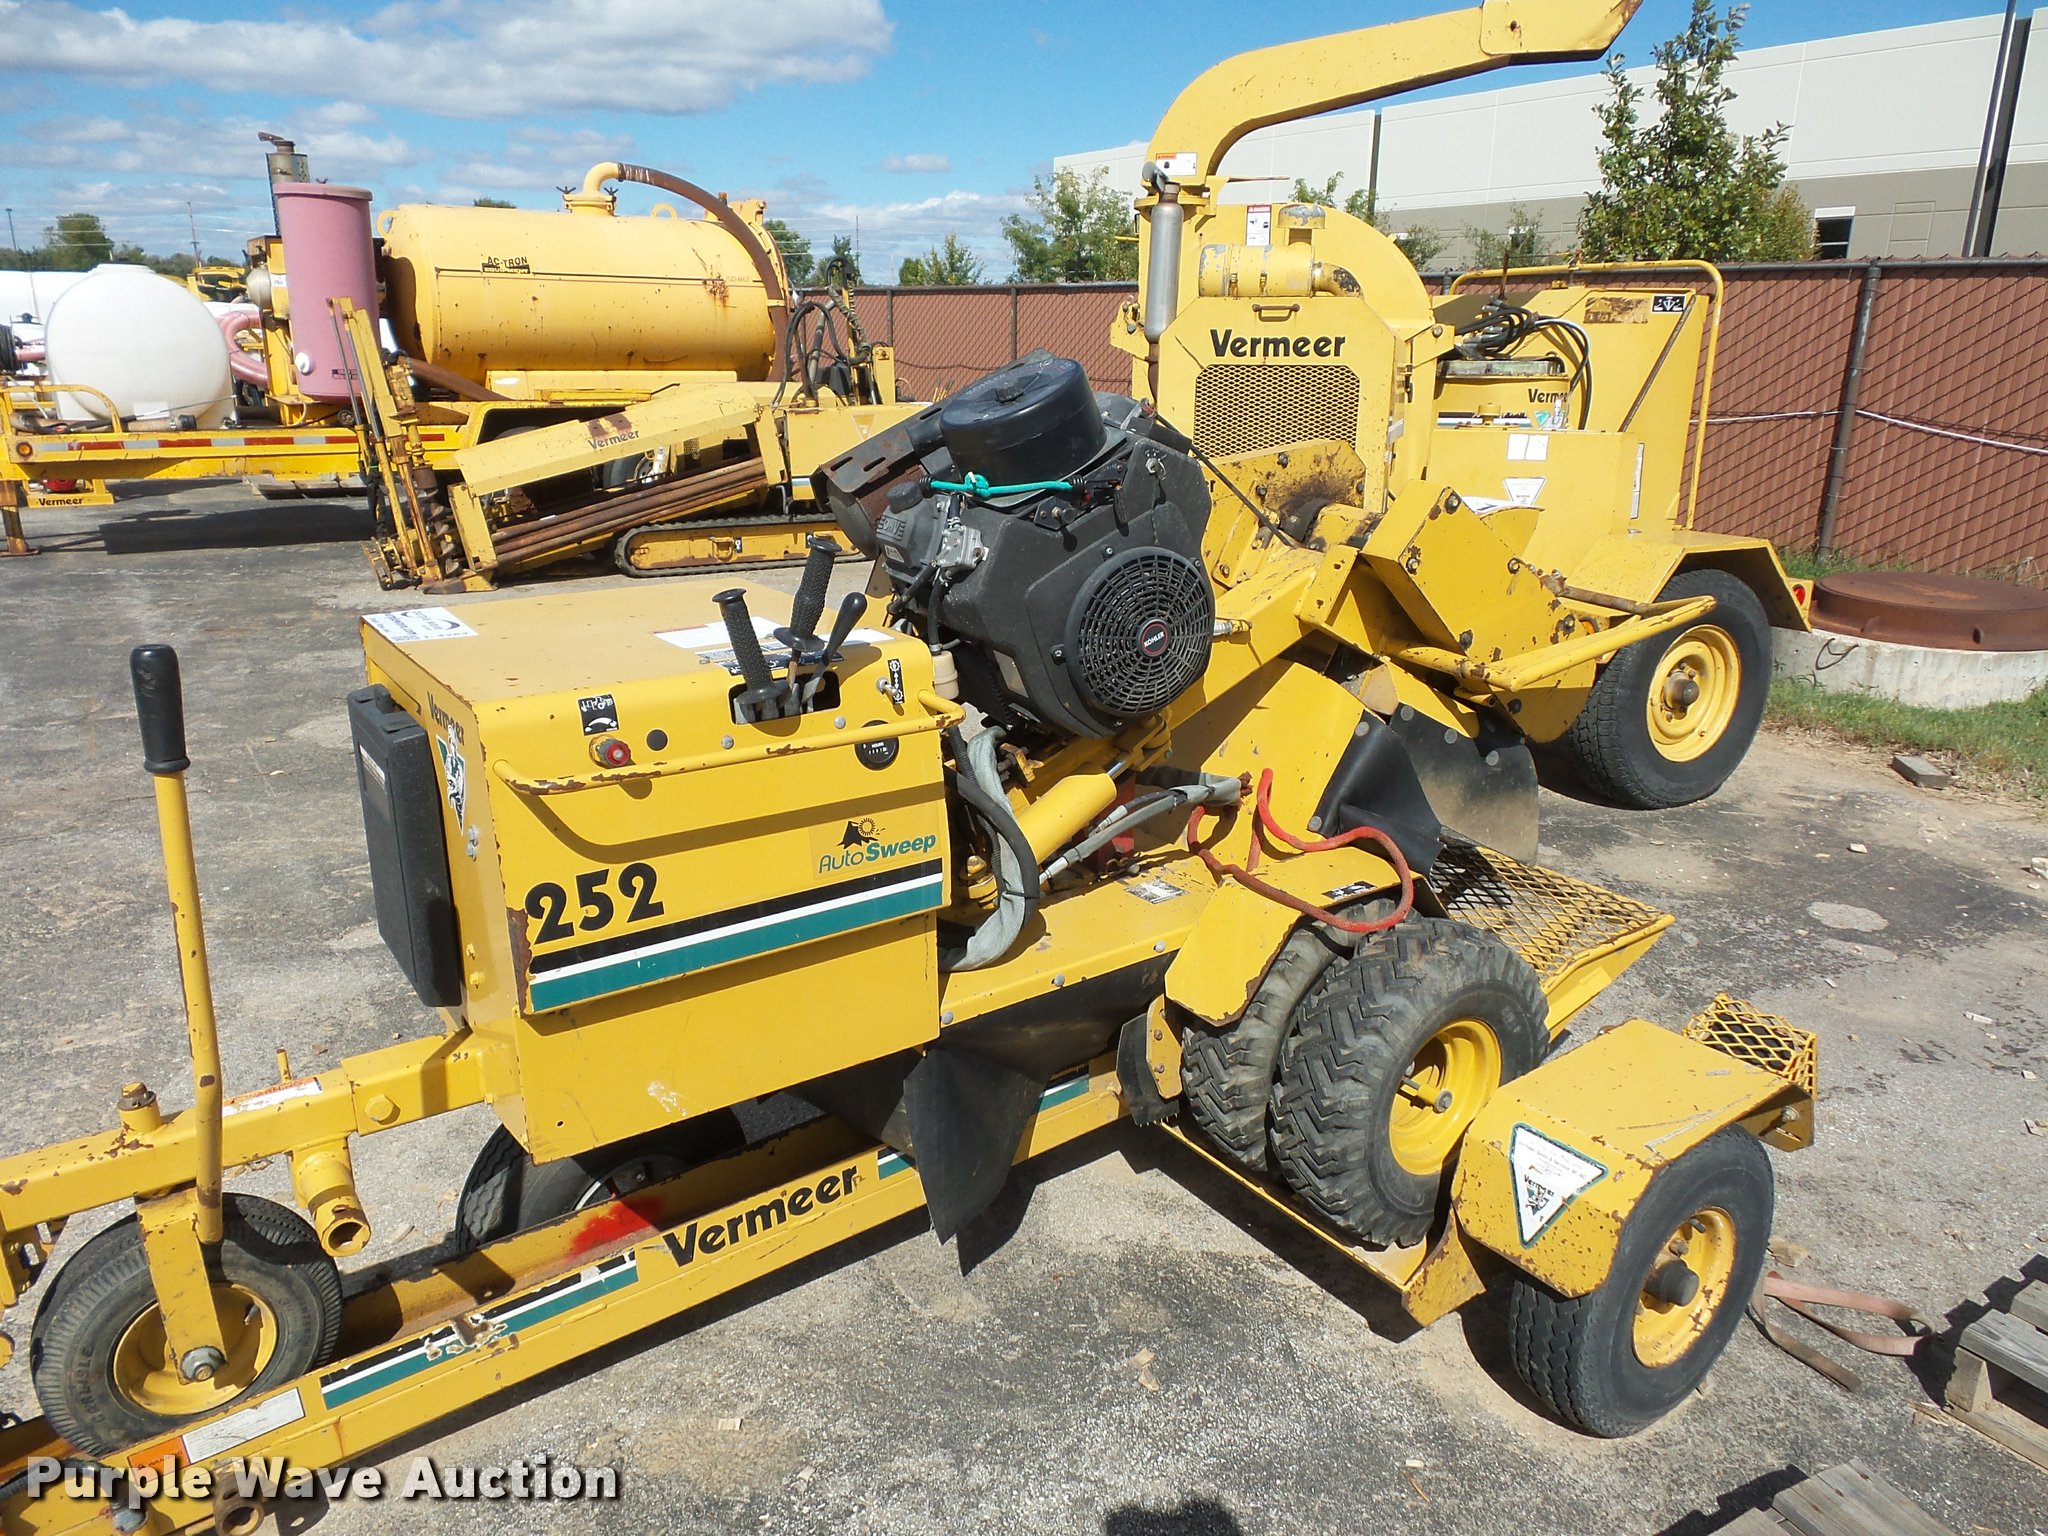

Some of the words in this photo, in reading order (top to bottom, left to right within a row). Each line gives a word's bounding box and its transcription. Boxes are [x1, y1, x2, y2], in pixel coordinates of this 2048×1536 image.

[1210, 328, 1346, 357] Vermeer
[588, 429, 639, 450] Vermeer
[39, 498, 83, 506] Vermeer
[1143, 631, 1165, 648] KOHLER
[426, 691, 464, 746] Vermeer
[818, 834, 937, 874] AutoSweep
[524, 862, 665, 945] 252
[1523, 1174, 1555, 1197] Vermeer
[662, 1165, 857, 1267] Vermeer
